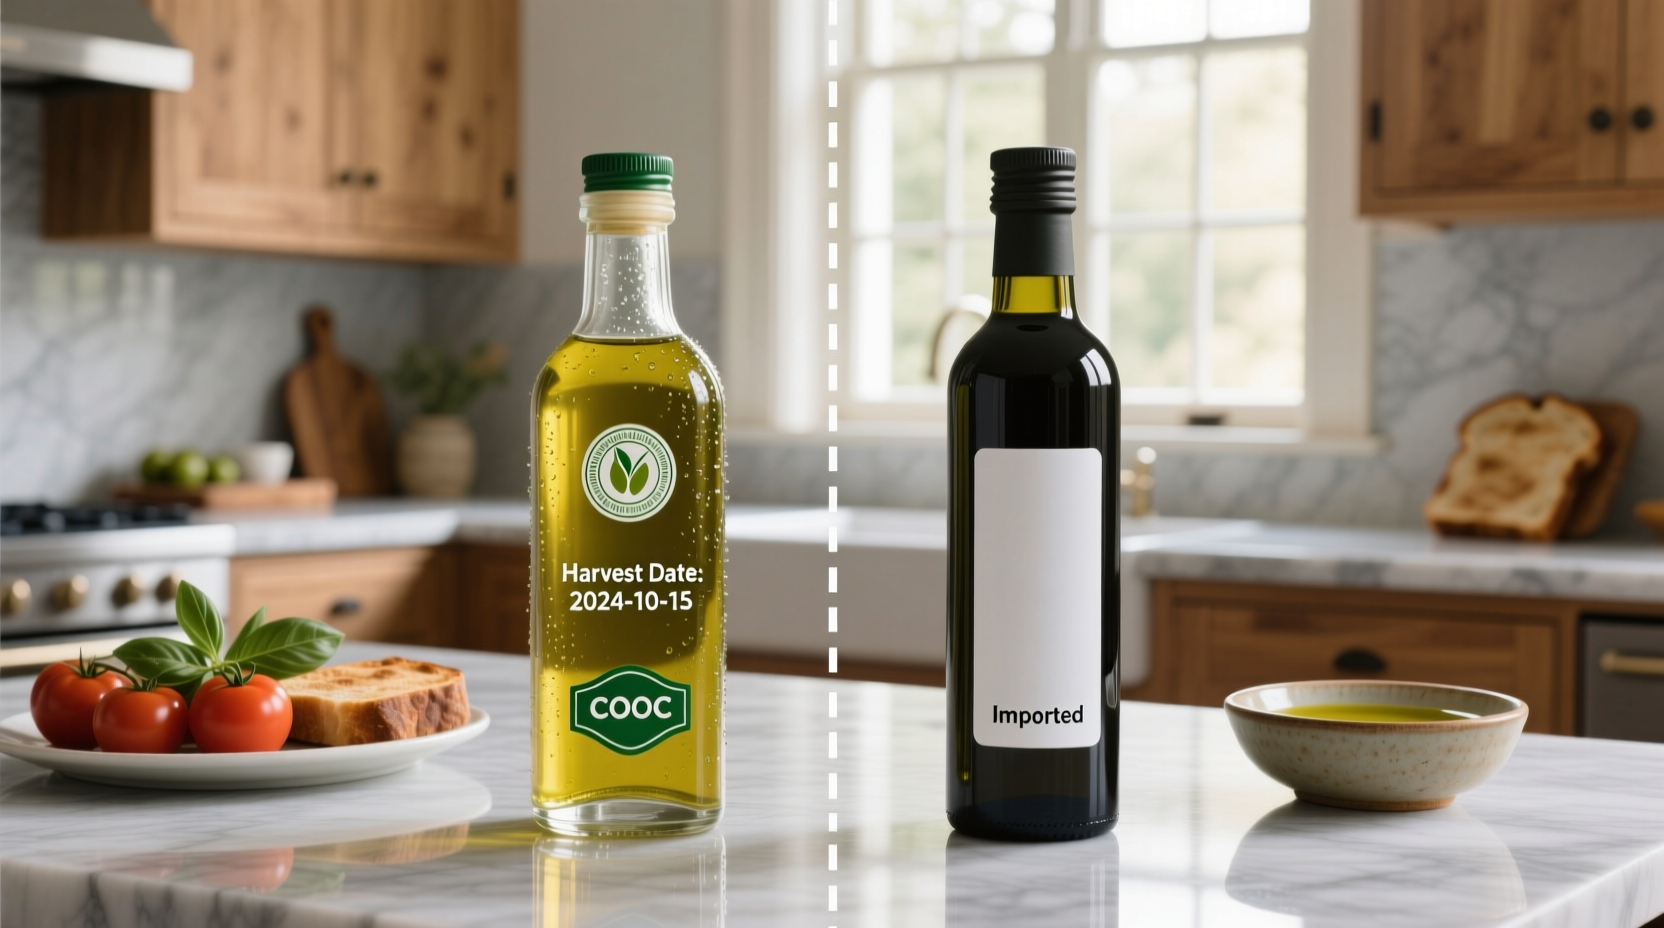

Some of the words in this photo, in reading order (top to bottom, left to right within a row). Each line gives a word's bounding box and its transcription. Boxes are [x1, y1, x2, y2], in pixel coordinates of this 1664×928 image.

[561, 562, 643, 583] Harvest
[649, 563, 704, 583] Date:
[569, 591, 693, 611] 2024-10-15
[590, 696, 672, 719] COOC
[993, 705, 1084, 728] Imported
